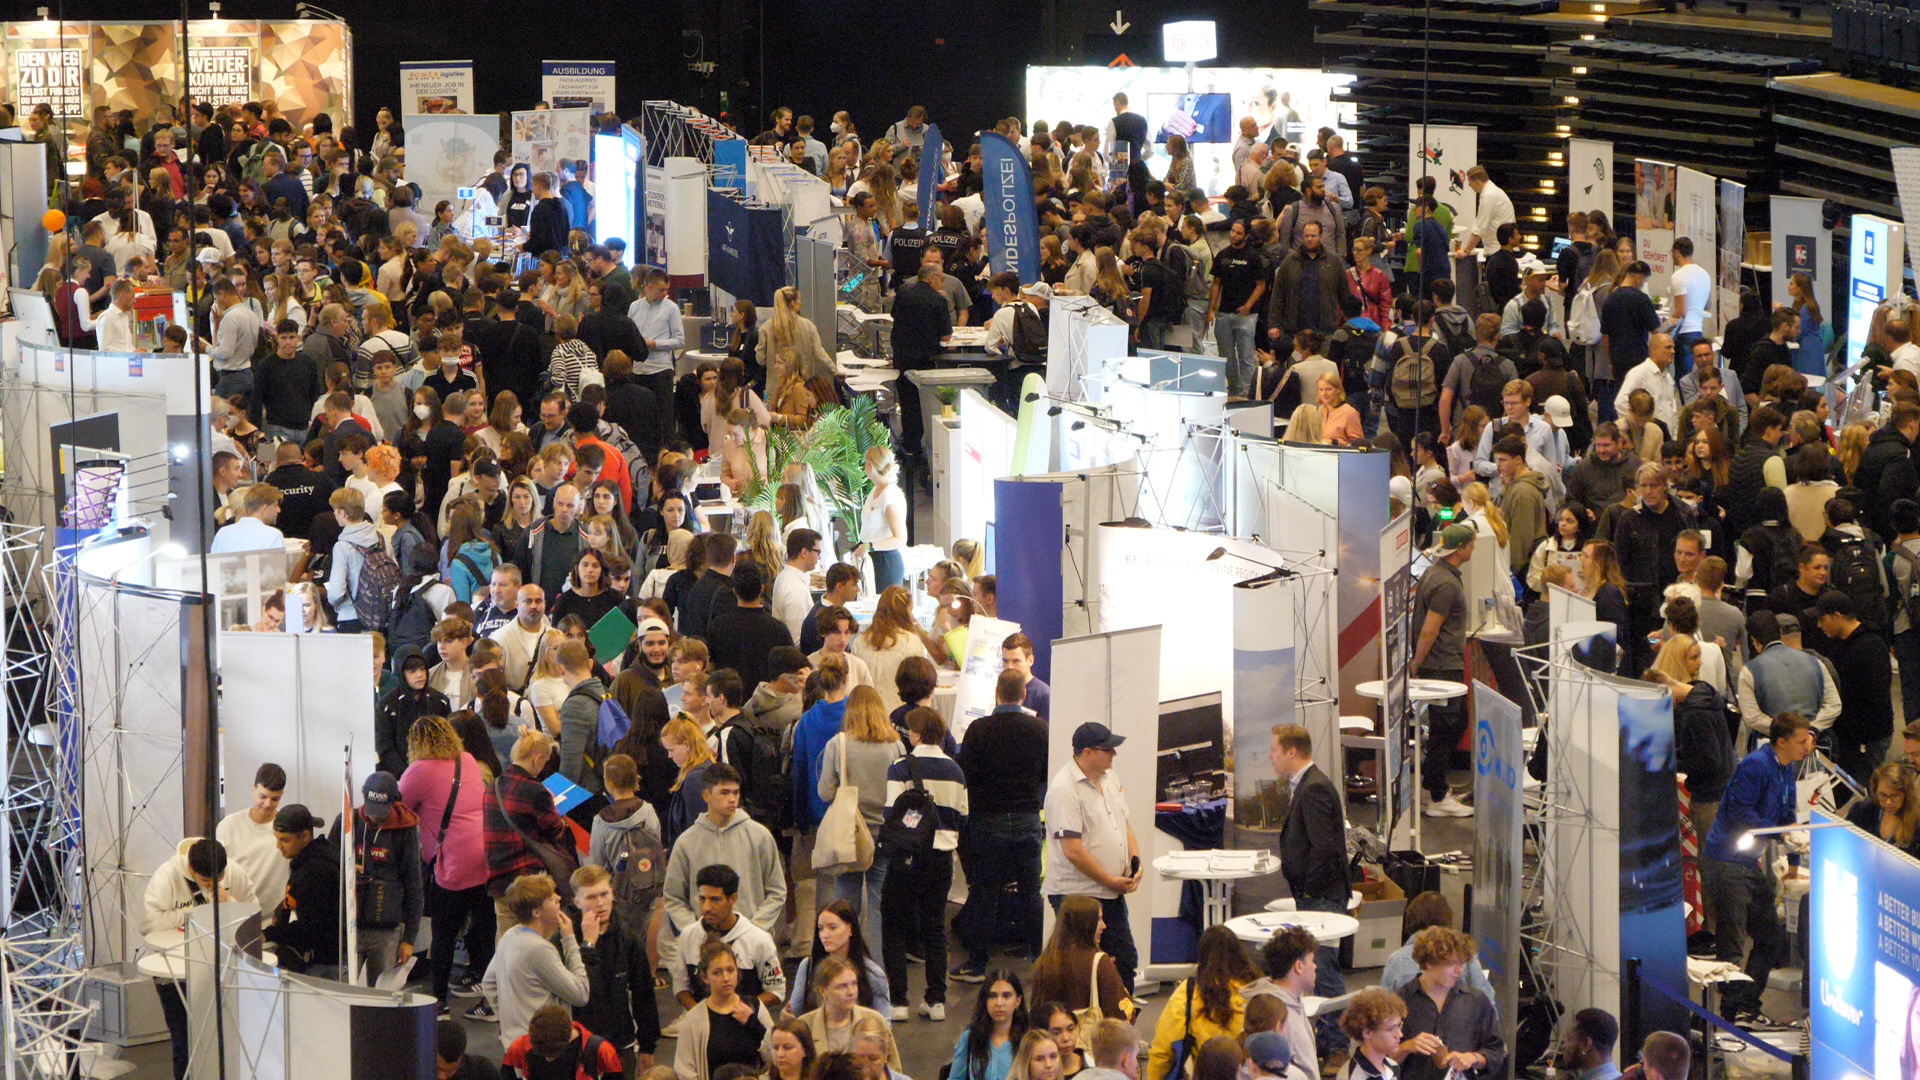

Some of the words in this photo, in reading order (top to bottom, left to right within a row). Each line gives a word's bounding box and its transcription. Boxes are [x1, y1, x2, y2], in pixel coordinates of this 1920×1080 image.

[20, 51, 45, 66] DEN
[47, 51, 79, 66] WEG
[188, 57, 248, 72] WEITER-
[20, 67, 44, 87] ZU
[47, 67, 79, 87] DIR
[440, 71, 465, 79] logistiker
[552, 67, 606, 75] AUSBILDUNG
[189, 73, 248, 86] KOMMEN.
[21, 87, 47, 96] SELBST
[49, 87, 80, 96] FINEST
[189, 87, 211, 95] NICHT
[213, 87, 228, 95] NUR
[230, 87, 248, 95] UMS
[893, 237, 922, 249] POLIZEI
[929, 235, 958, 245] POLIZEI
[281, 484, 315, 496] curity
[1125, 554, 1142, 565] BEI
[367, 790, 388, 800] BOSS
[1878, 890, 1883, 907] A
[1884, 893, 1910, 924] BETTER
[1878, 911, 1883, 928] A
[1884, 914, 1910, 945] BETTER
[1878, 933, 1883, 950] A
[1884, 936, 1910, 967] BETTER
